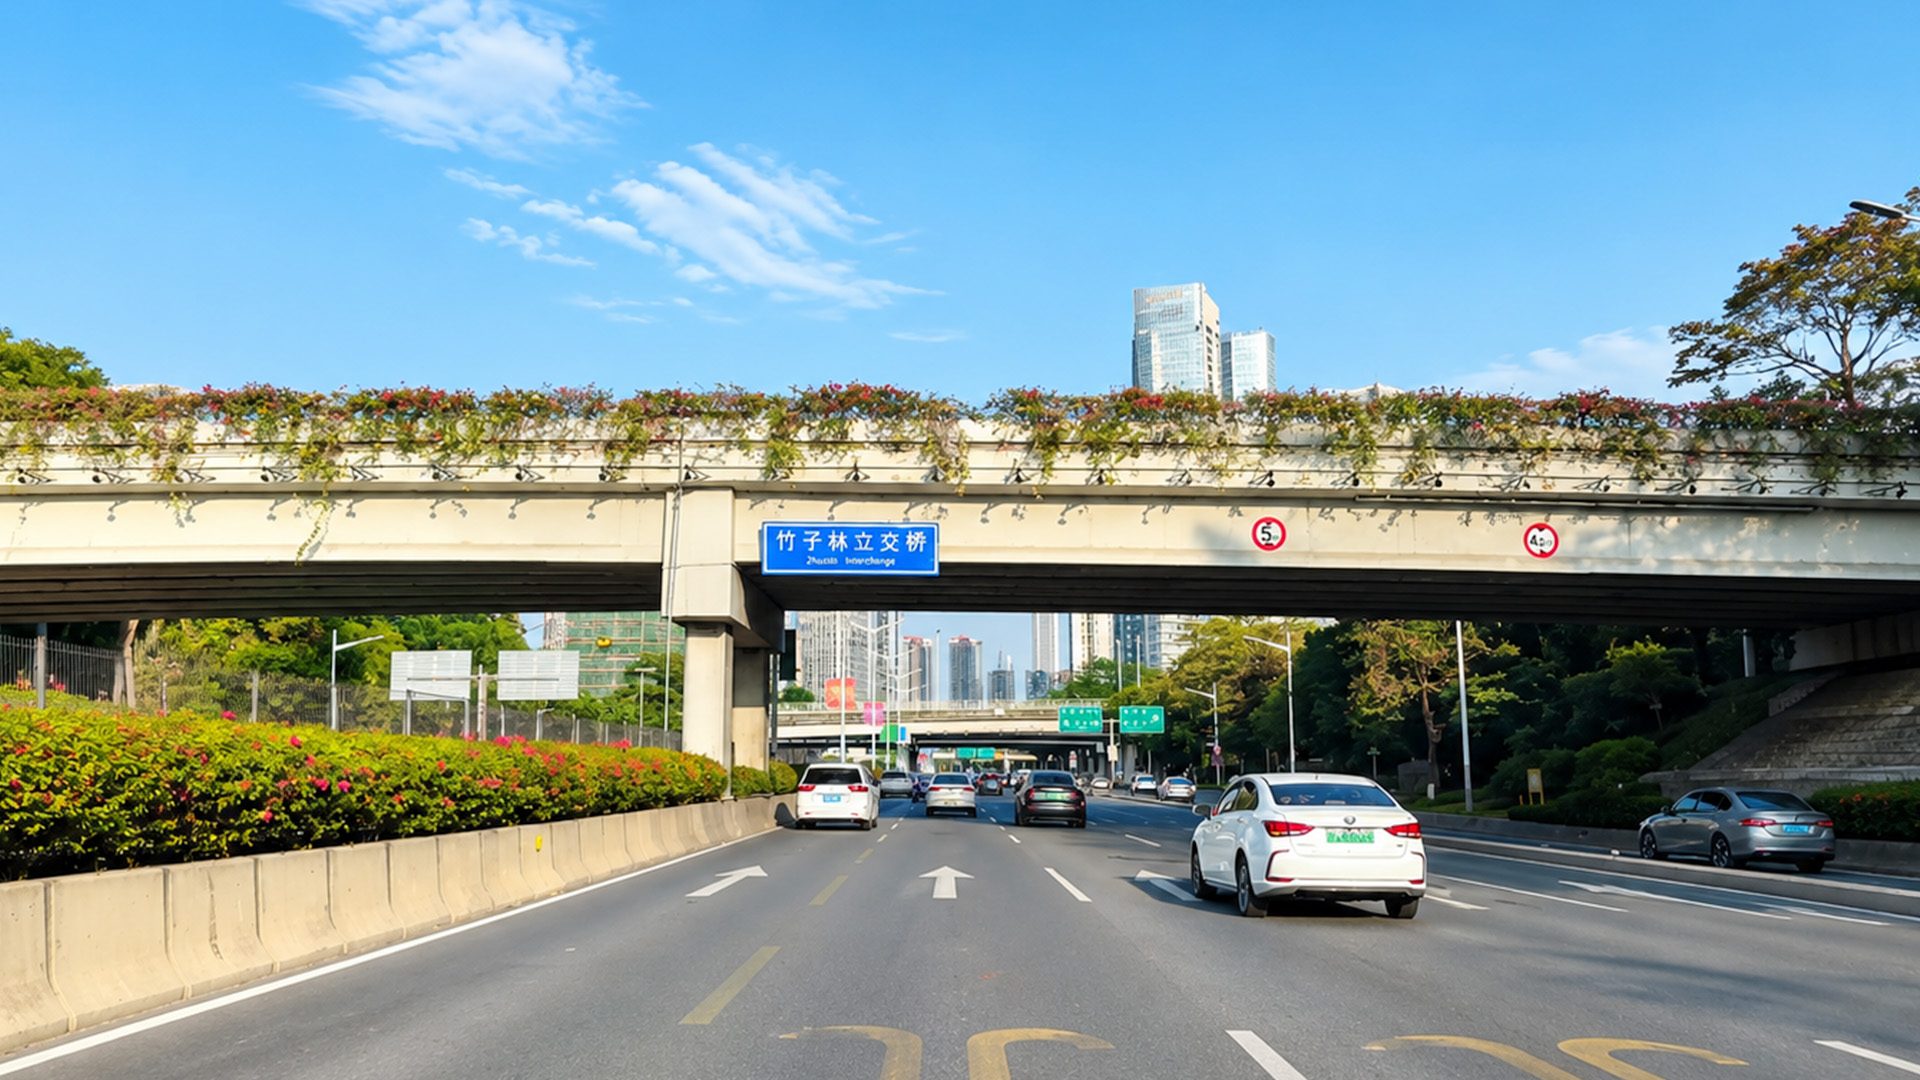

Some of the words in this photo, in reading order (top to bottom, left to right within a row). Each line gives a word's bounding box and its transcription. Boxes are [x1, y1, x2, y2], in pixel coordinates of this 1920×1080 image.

[776, 529, 927, 553] 竹子林立交桥
